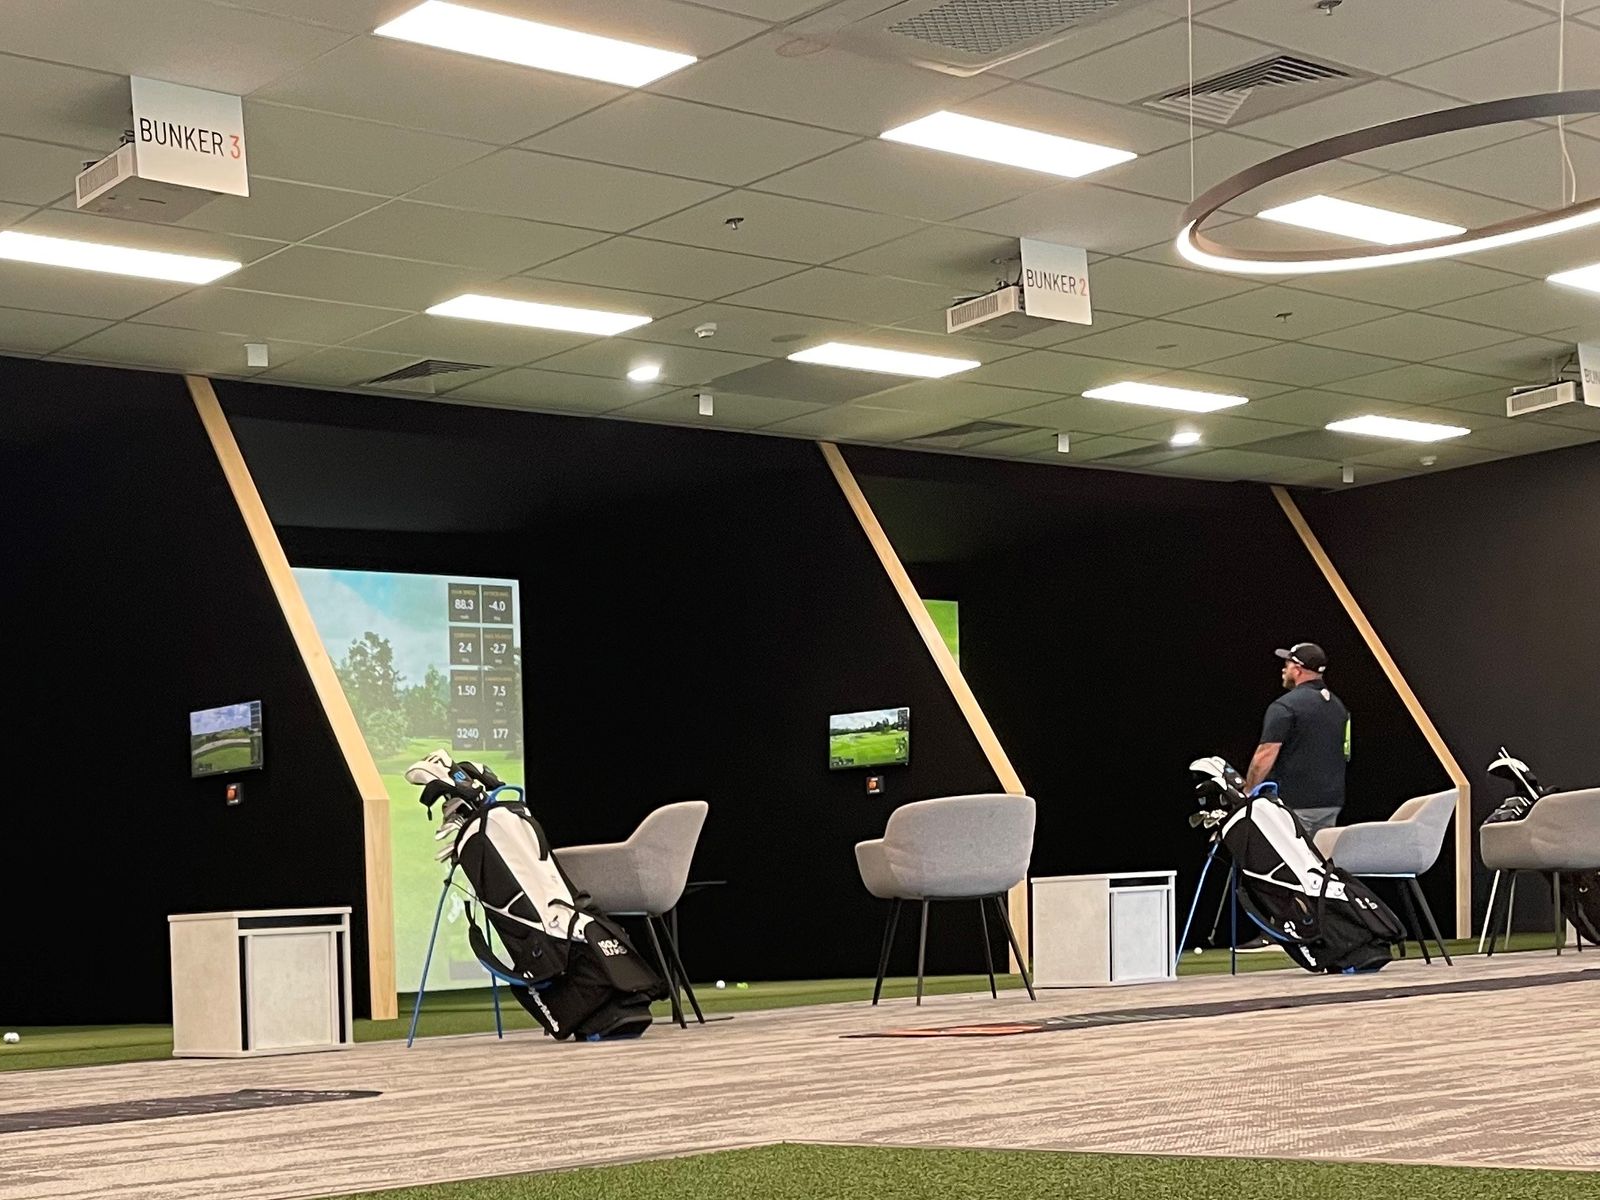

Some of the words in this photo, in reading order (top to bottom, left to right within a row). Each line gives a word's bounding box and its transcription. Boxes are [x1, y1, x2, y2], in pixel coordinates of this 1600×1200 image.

[140, 117, 224, 157] BUNKER
[229, 135, 241, 159] 3
[1026, 268, 1077, 295] BUNKER
[1079, 278, 1088, 297] 2
[455, 599, 474, 610] 88.3
[493, 728, 508, 739] 177
